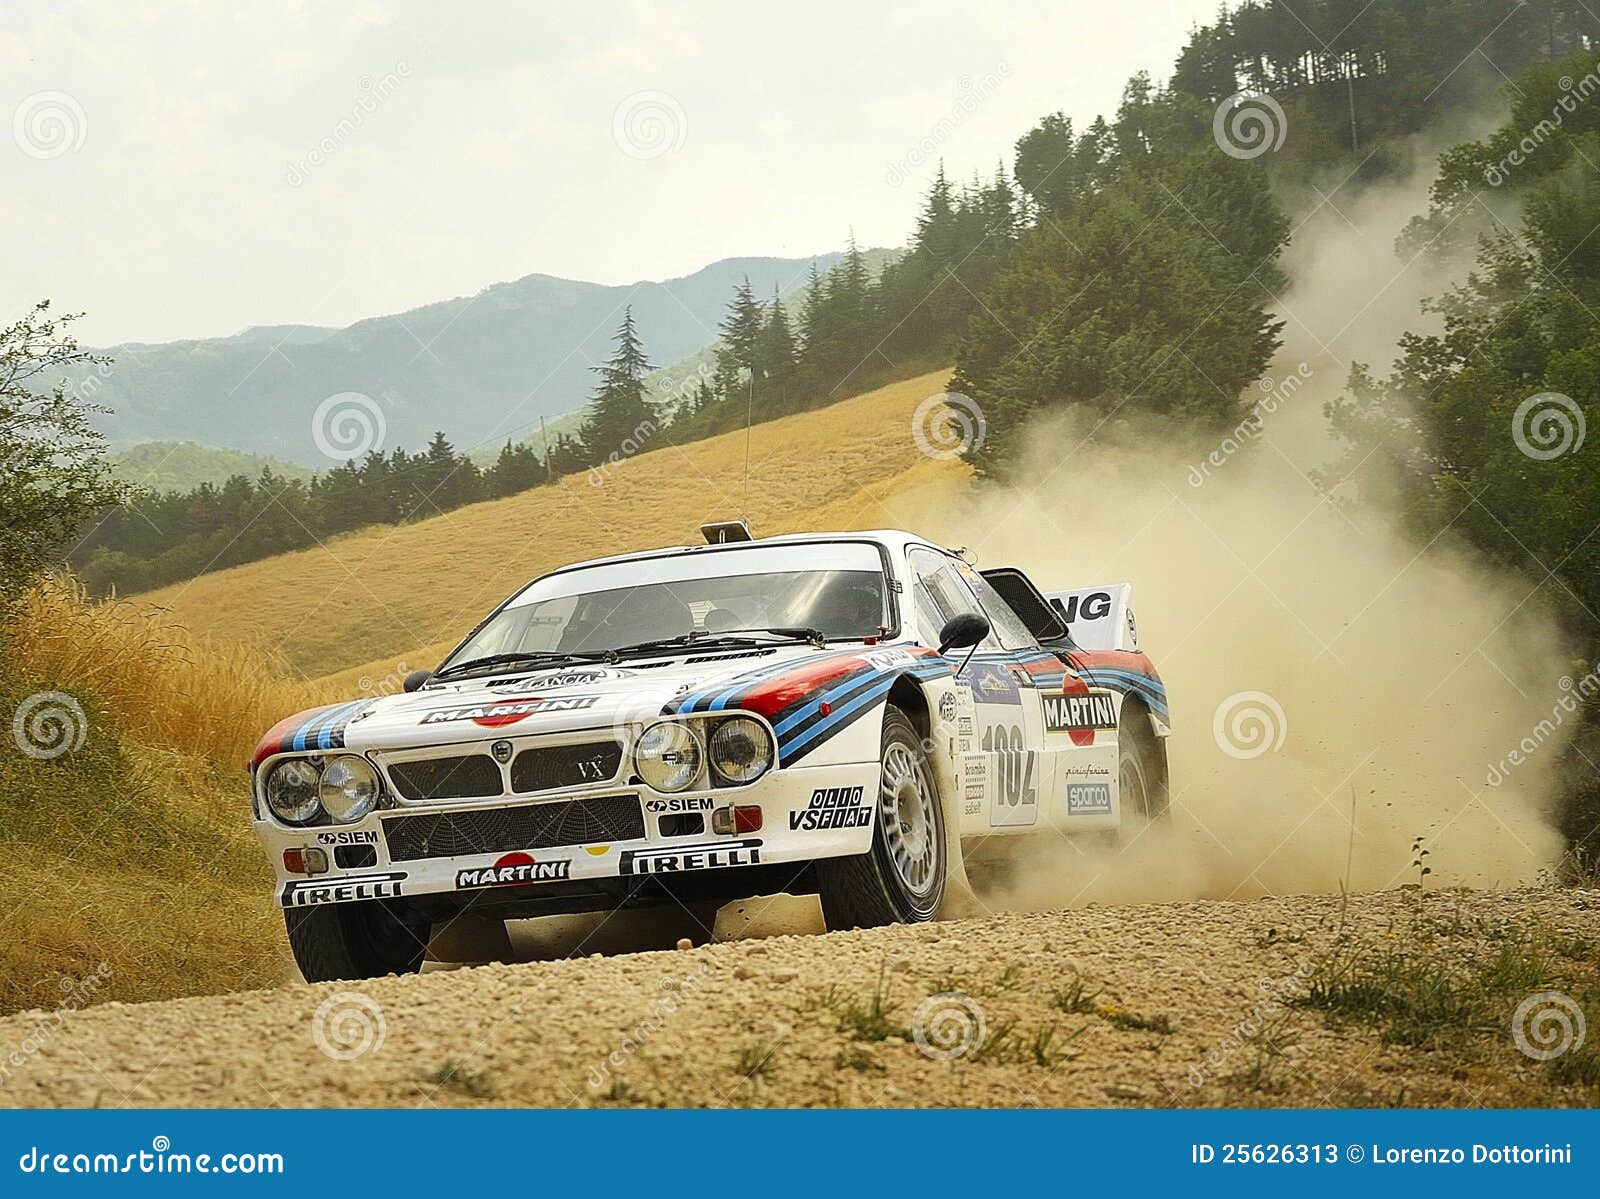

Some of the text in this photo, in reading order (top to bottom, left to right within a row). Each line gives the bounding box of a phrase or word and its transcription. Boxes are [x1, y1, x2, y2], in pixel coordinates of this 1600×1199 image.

[529, 673, 594, 689] LANCIA
[427, 698, 594, 724] MARTINI
[1044, 697, 1115, 728] MARTINI
[981, 724, 1036, 807] 102
[669, 797, 714, 811] SIEM
[811, 787, 863, 808] OLIO
[338, 831, 379, 844] SIEM
[460, 861, 567, 887] MARTINI
